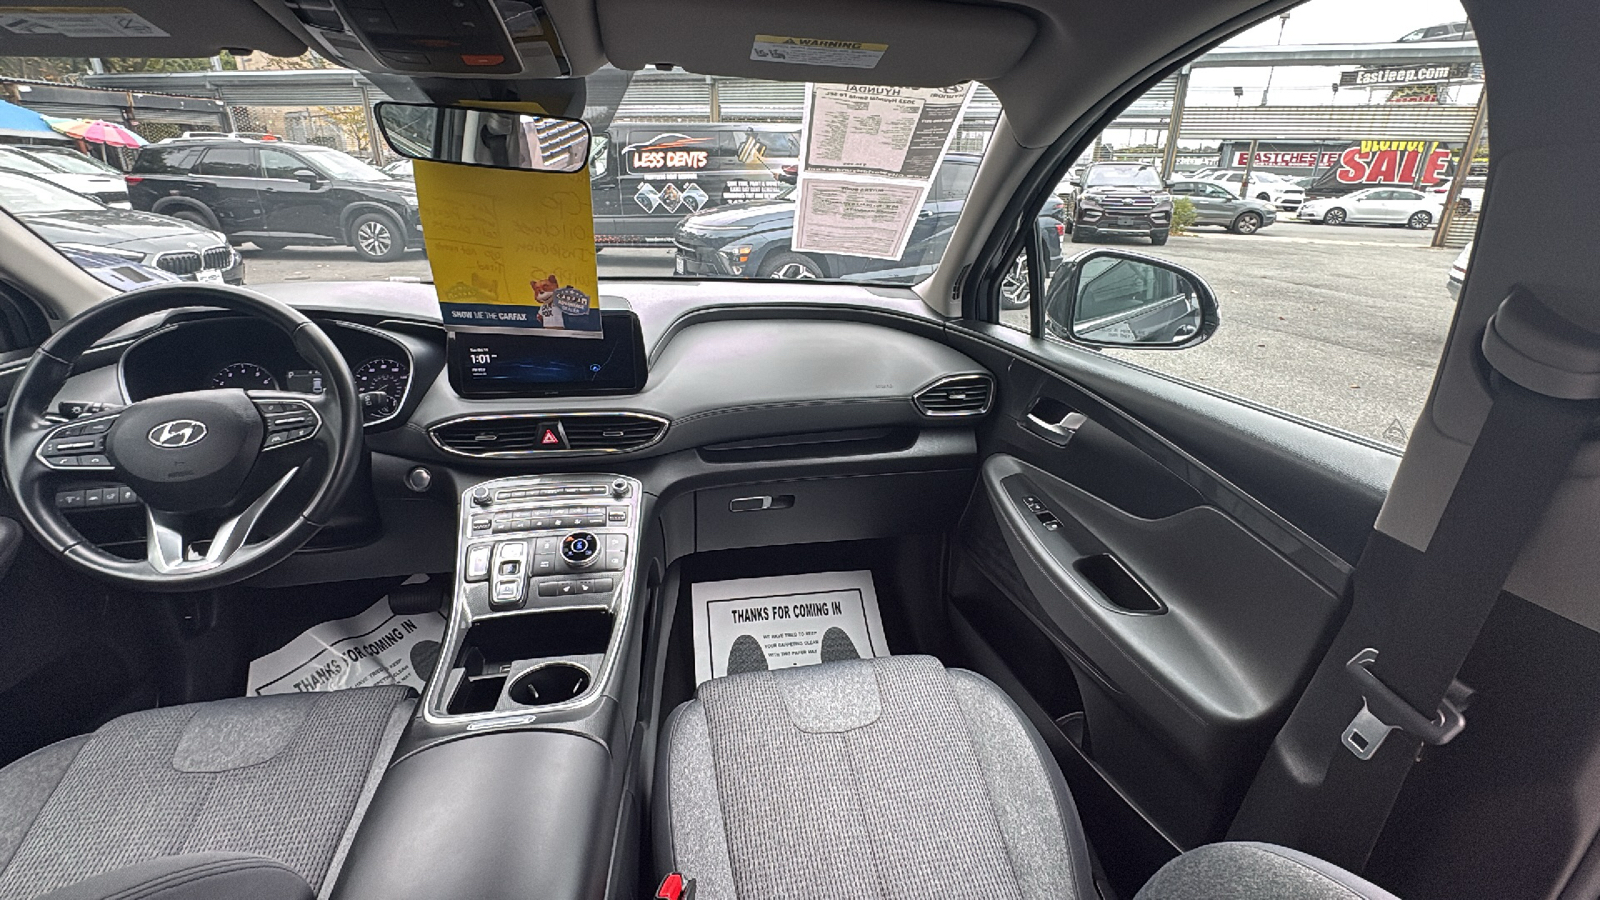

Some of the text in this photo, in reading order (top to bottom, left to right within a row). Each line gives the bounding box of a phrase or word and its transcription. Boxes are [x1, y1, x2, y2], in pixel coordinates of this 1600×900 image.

[800, 39, 862, 49] WARNING
[633, 151, 709, 169] LESS DENTS
[1238, 153, 1342, 165] EASTCHESTE
[1337, 146, 1451, 185] SALE
[451, 310, 473, 319] SHOW
[486, 312, 498, 320] THE
[498, 312, 528, 321] CARFAX
[470, 354, 491, 364] 1:01
[731, 601, 843, 624] THANKS FOR COMING IN
[293, 659, 343, 692] THANKS
[363, 627, 404, 657] COMING
[400, 618, 418, 635] IN
